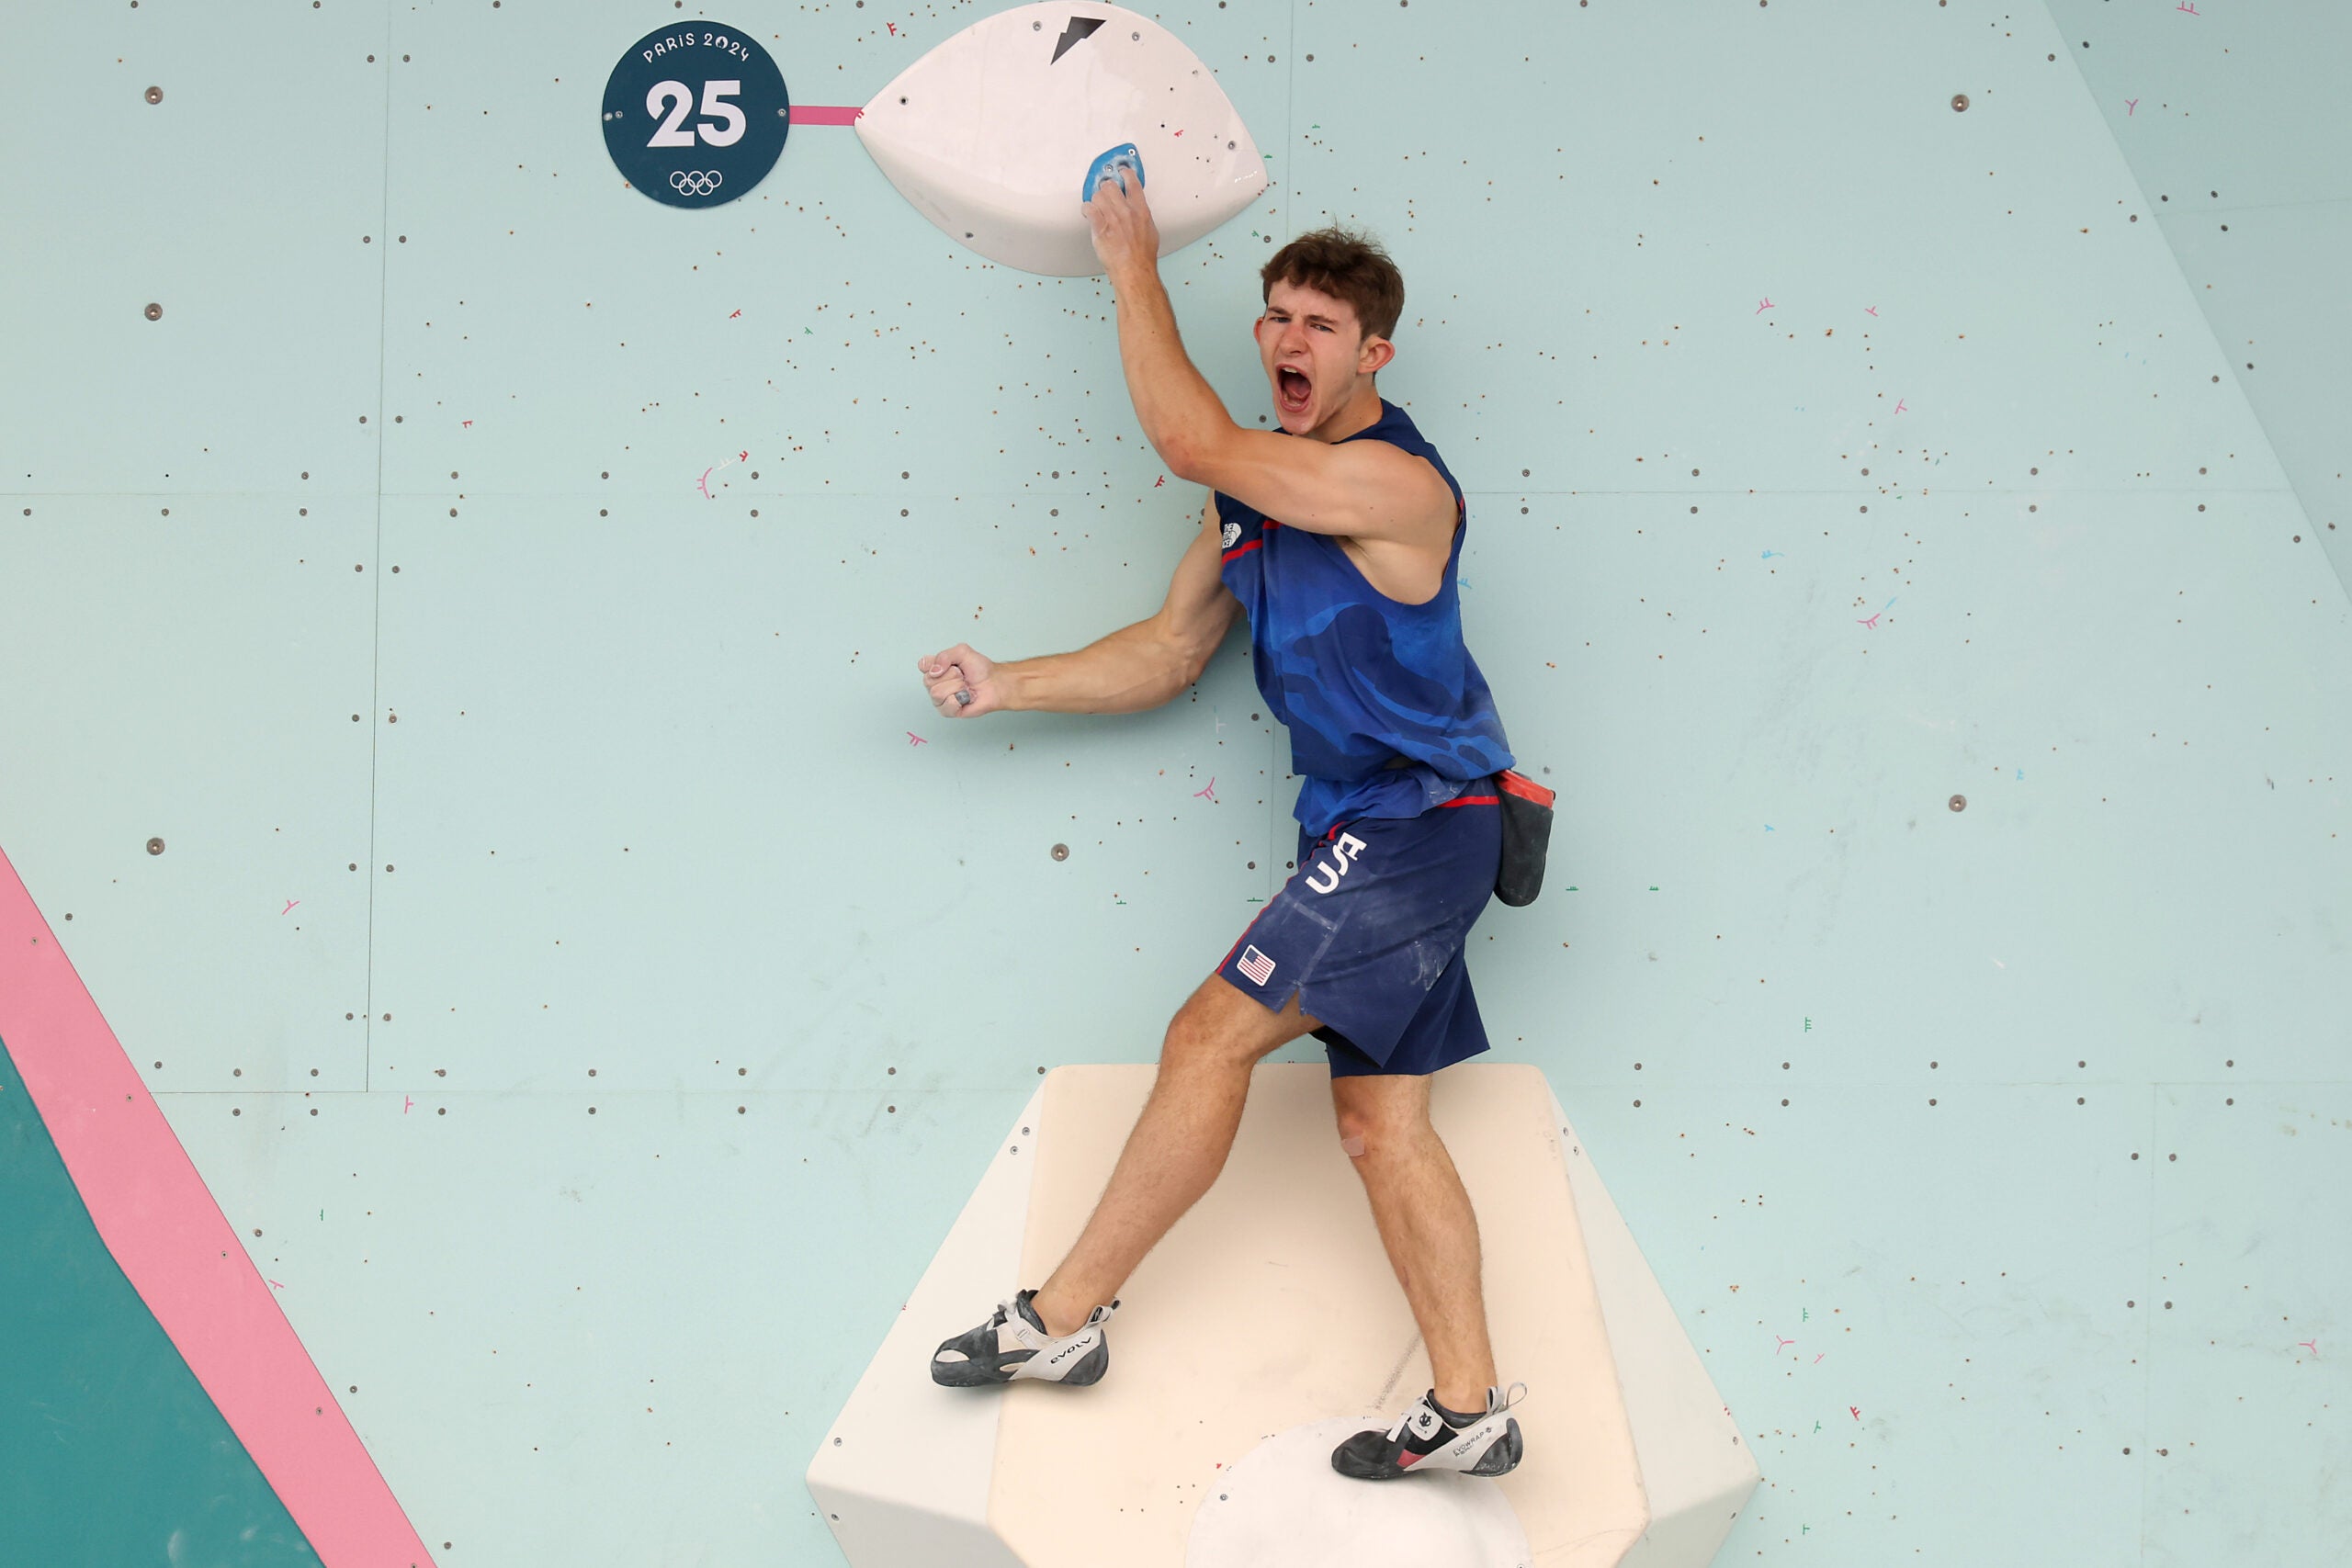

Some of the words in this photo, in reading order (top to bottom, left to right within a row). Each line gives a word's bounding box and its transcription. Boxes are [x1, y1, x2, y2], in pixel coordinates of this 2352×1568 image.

[643, 32, 695, 63] PARIS
[703, 33, 750, 62] 2024
[646, 80, 747, 148] 25
[1305, 831, 1367, 895] USA
[1453, 1431, 1485, 1455] EVOWRAP
